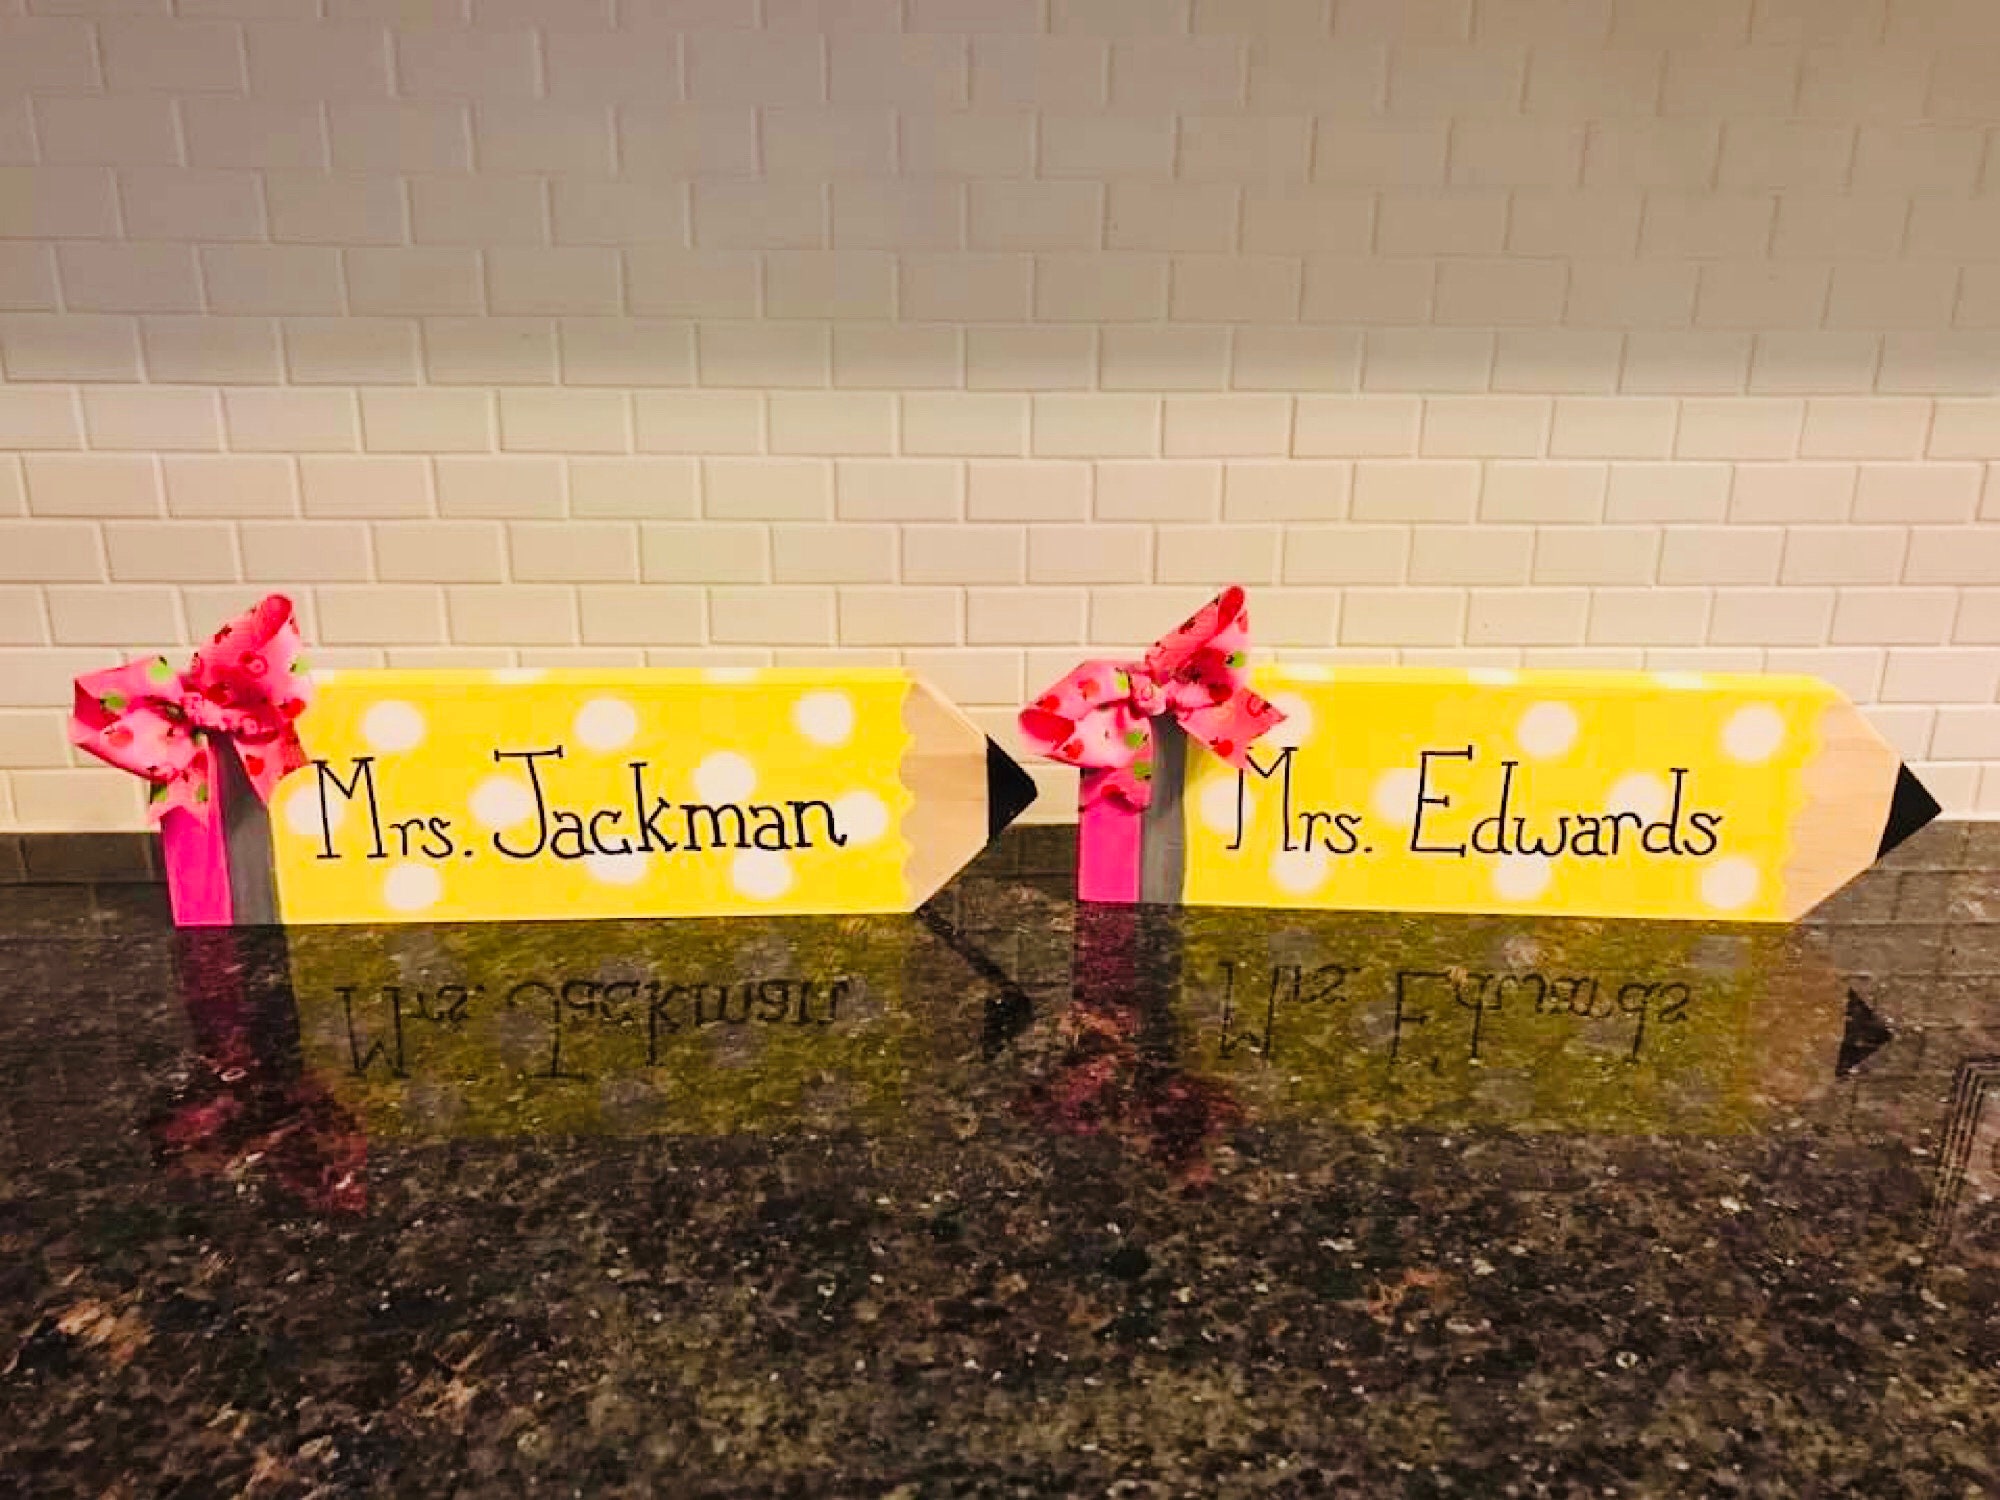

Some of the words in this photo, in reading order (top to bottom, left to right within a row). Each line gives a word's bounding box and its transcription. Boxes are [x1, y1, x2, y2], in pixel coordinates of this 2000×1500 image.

[312, 756, 474, 859] Mrs.
[493, 744, 848, 860] Jackman
[1225, 746, 1374, 854] Mrs.
[1410, 744, 1722, 858] Edwards
